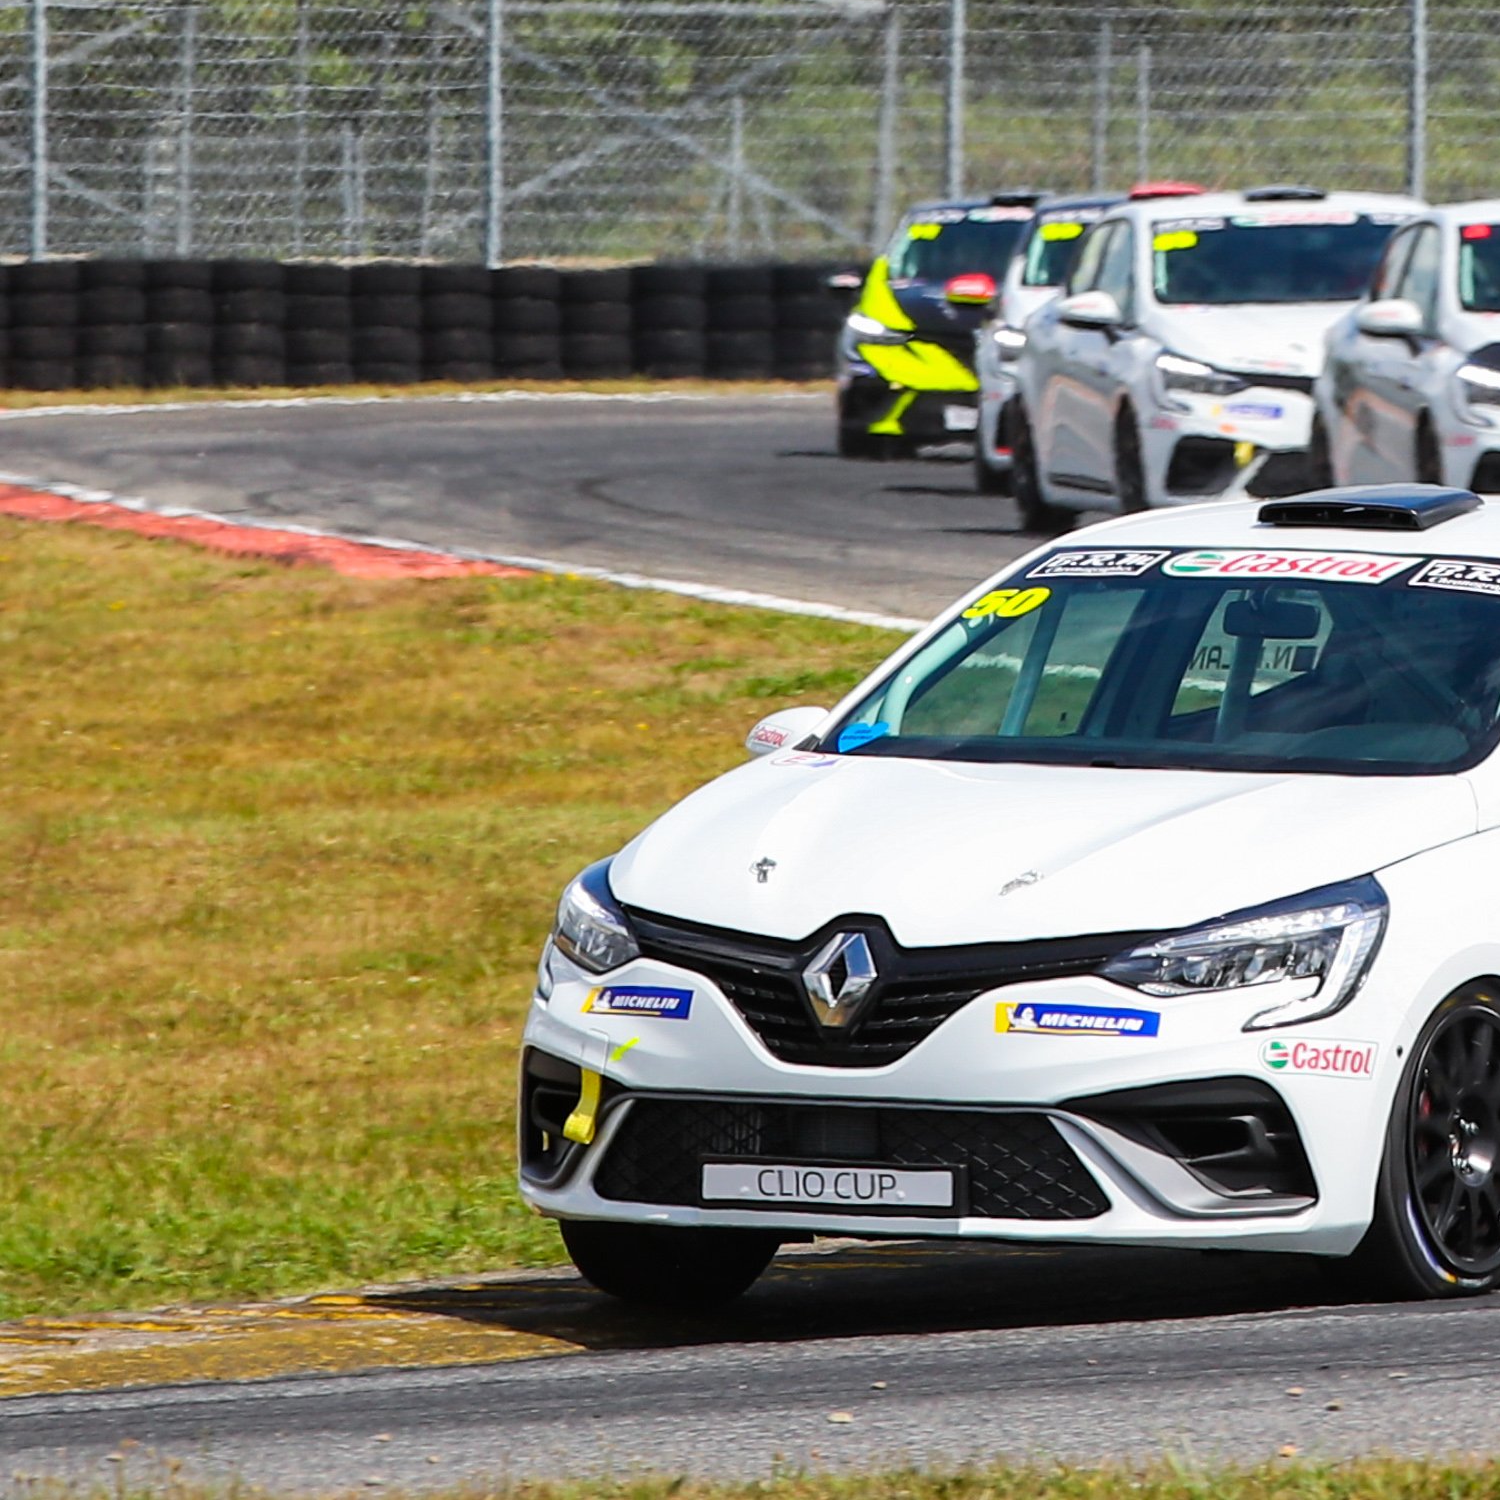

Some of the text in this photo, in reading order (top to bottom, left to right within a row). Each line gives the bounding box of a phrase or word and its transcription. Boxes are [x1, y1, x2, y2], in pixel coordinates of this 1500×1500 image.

[1218, 553, 1403, 579] Castrol
[961, 586, 1052, 620] 50
[611, 995, 681, 1010] MICHELIN
[1039, 1012, 1144, 1032] MICHELIN
[1292, 1042, 1372, 1074] Castrol
[757, 1169, 897, 1200] CLIO CUP
